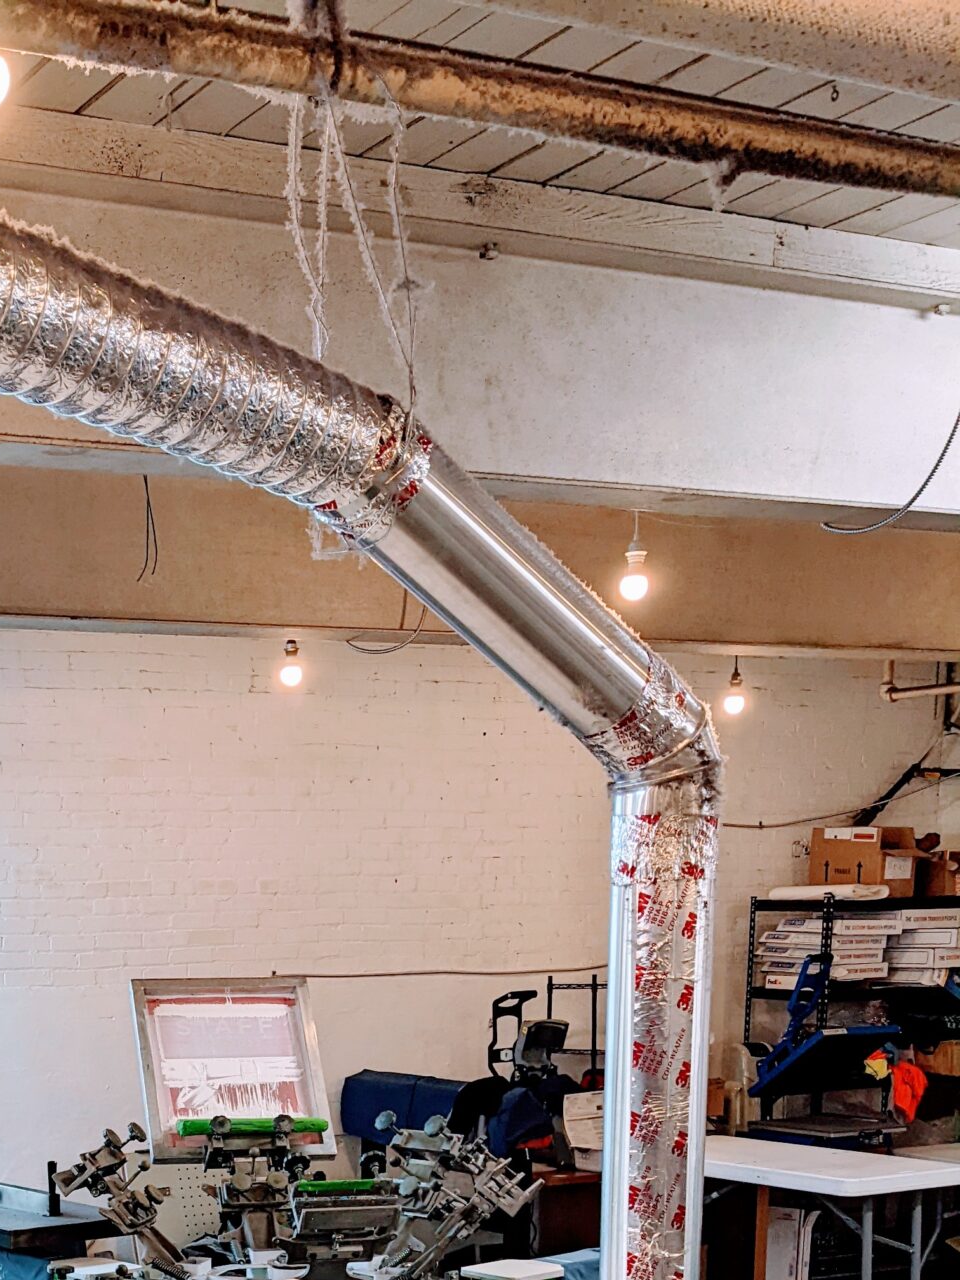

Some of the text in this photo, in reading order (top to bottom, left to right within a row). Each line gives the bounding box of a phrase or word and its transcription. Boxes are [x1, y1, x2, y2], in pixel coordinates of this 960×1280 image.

[682, 911, 698, 940] 3M
[677, 984, 695, 1012] 3M
[675, 1061, 691, 1088] 3M
[671, 1130, 688, 1158] 3M
[671, 1204, 686, 1231] 3M
